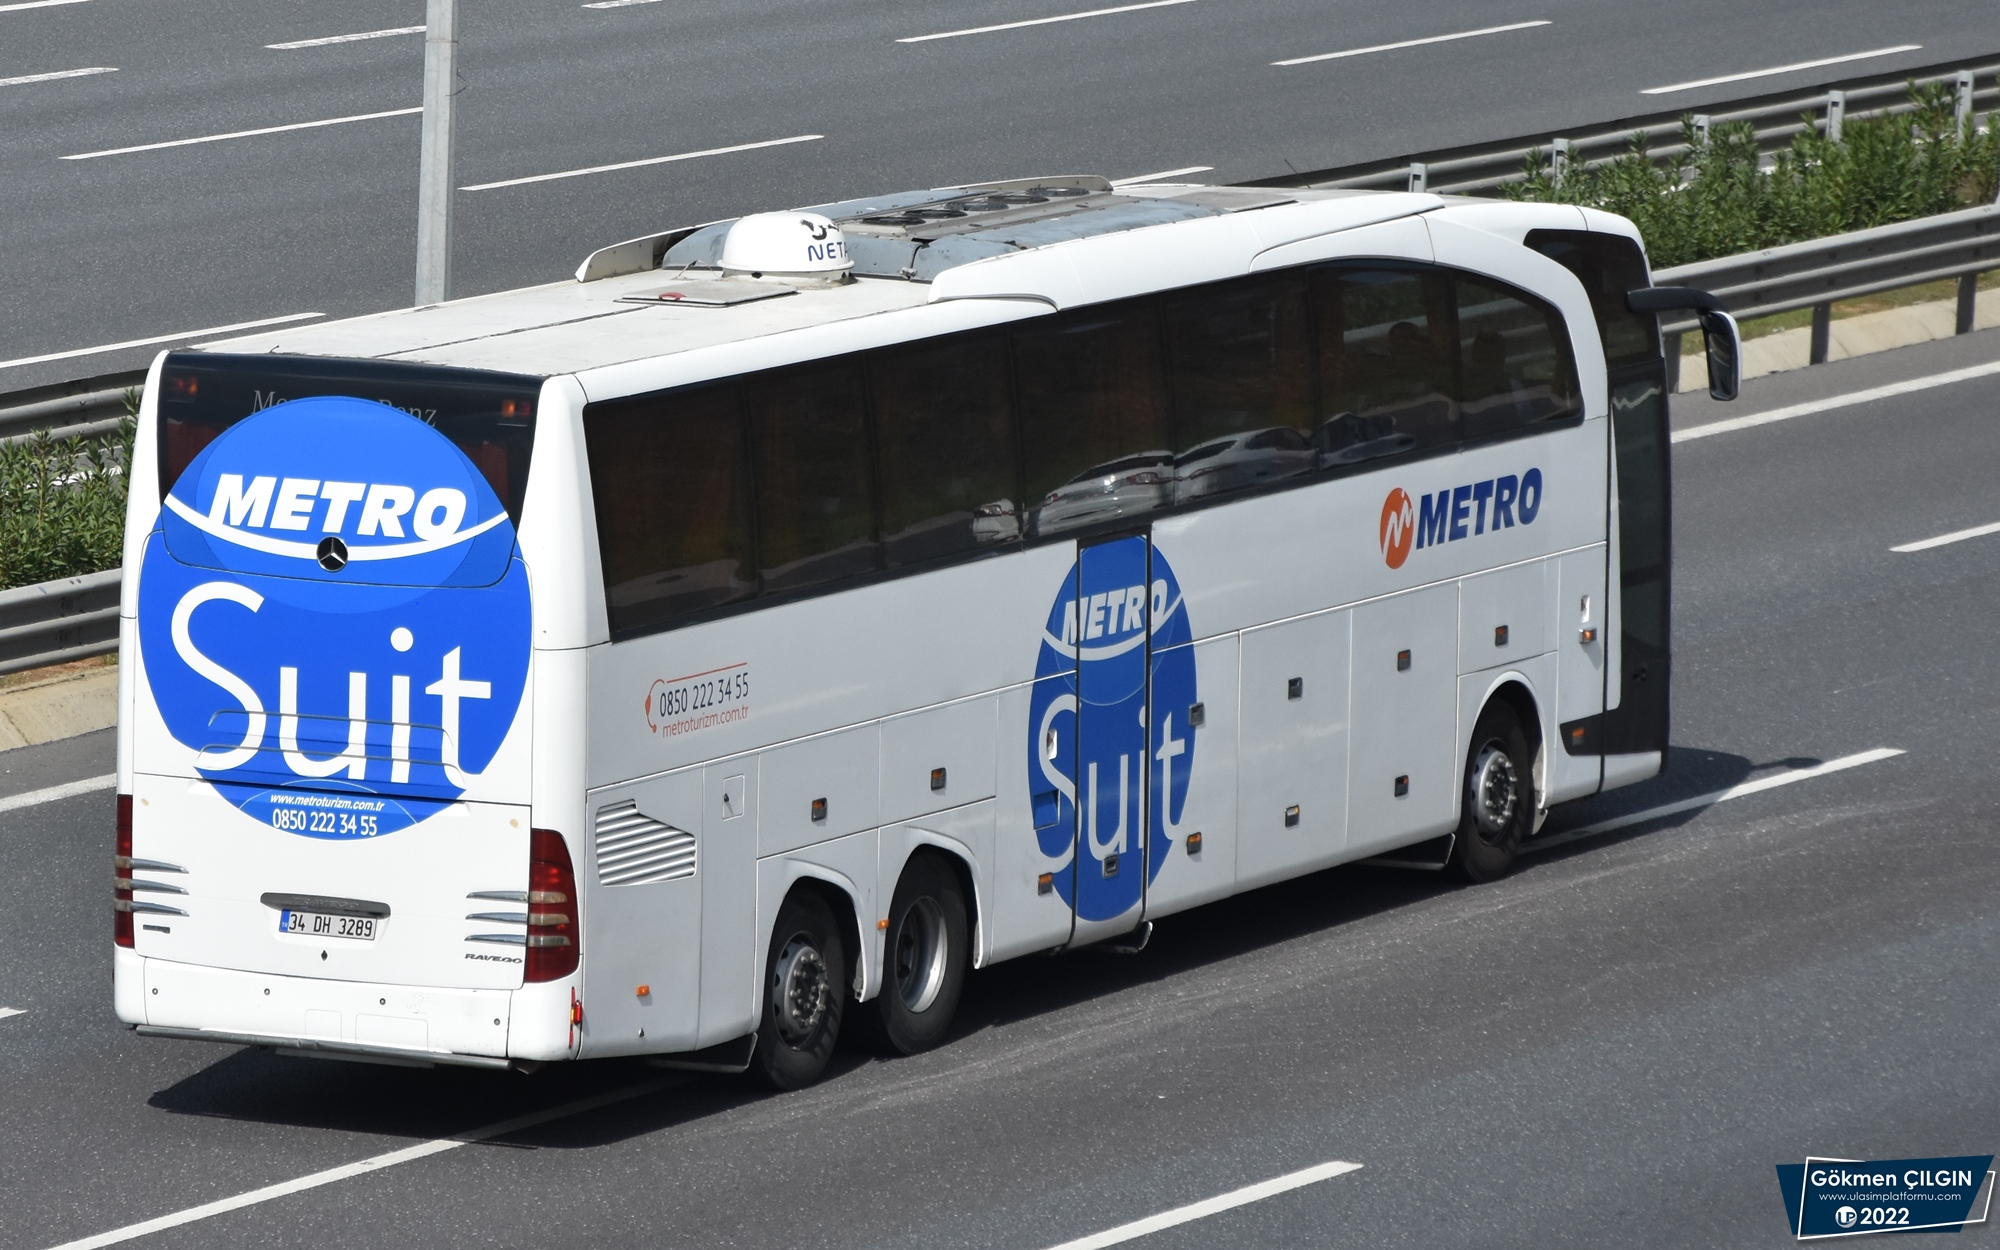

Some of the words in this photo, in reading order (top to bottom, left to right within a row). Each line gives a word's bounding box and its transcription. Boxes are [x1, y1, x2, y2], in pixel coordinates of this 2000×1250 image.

[207, 473, 467, 542] METRO
[1416, 467, 1543, 550] METRO
[1061, 579, 1168, 646] METRO
[171, 581, 492, 786] Suit
[660, 688, 688, 717] 0850
[692, 682, 714, 710] 222
[718, 677, 732, 704] 34
[735, 672, 749, 699] 55
[662, 706, 749, 738] metroturizm.com.tr
[270, 794, 385, 812] www.metroturizm.com.tr
[1039, 694, 1186, 874] Suit
[272, 808, 307, 831] 0850
[309, 811, 336, 834] 222
[339, 813, 358, 835] 34
[360, 815, 378, 837] 55
[288, 913, 306, 932] 34
[313, 915, 332, 934] DH
[338, 918, 373, 937] 3289
